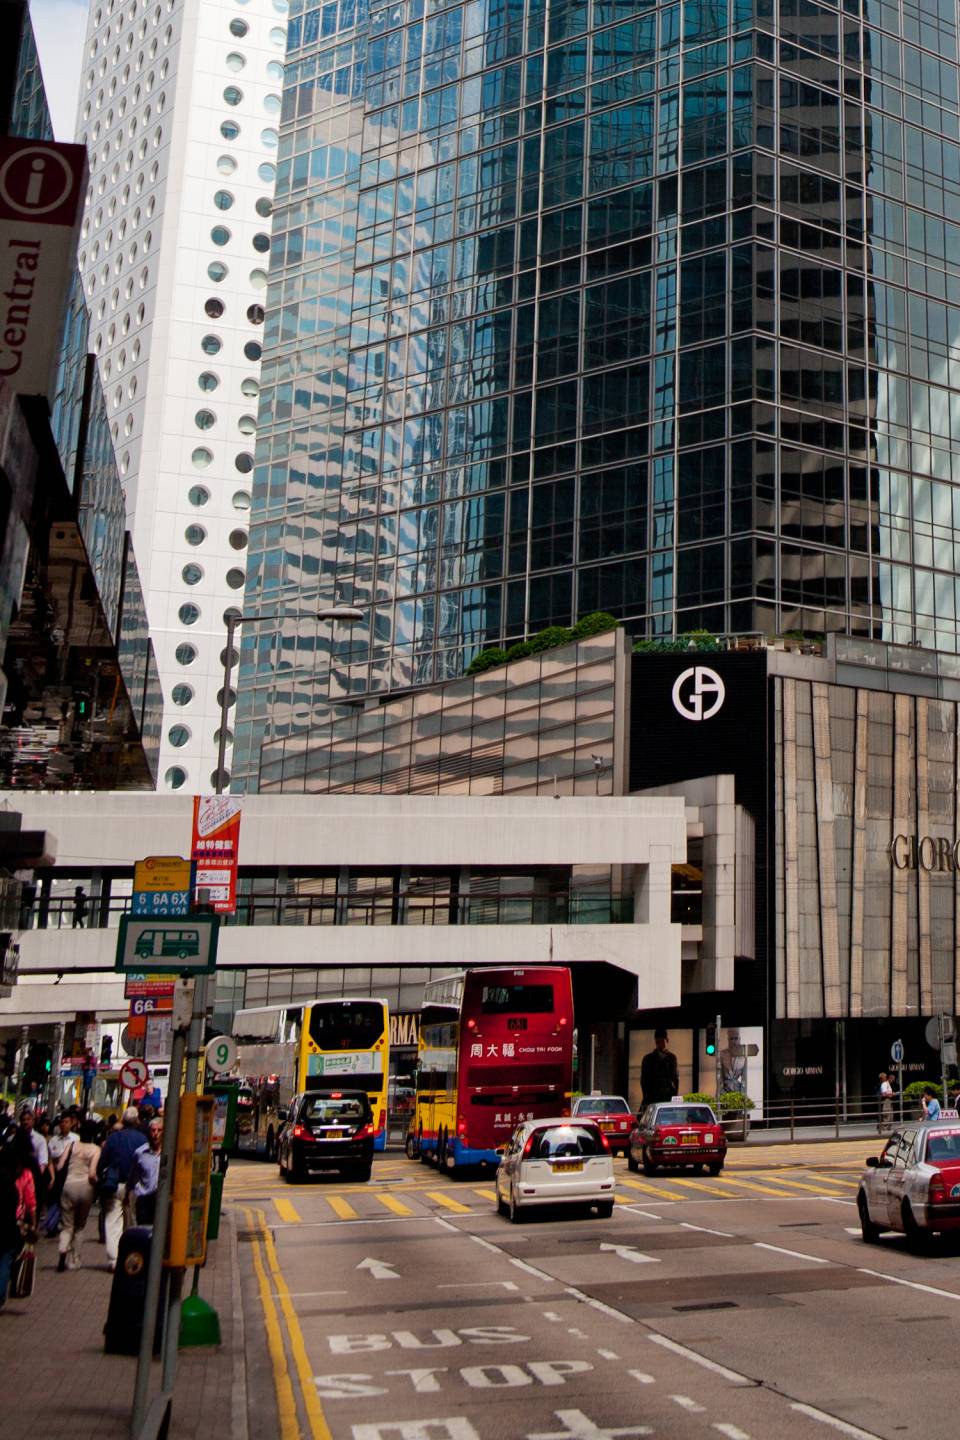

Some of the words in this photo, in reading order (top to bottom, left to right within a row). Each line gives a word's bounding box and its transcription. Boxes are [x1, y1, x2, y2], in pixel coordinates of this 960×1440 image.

[0, 240, 42, 377] Central
[139, 892, 147, 905] 6
[153, 892, 169, 906] 6A
[171, 891, 188, 906] 6X
[133, 999, 155, 1015] 66
[217, 1044, 229, 1066] 9
[940, 1111, 957, 1119] TAXI
[327, 1326, 533, 1354] BUS
[312, 1359, 595, 1399] STOP
